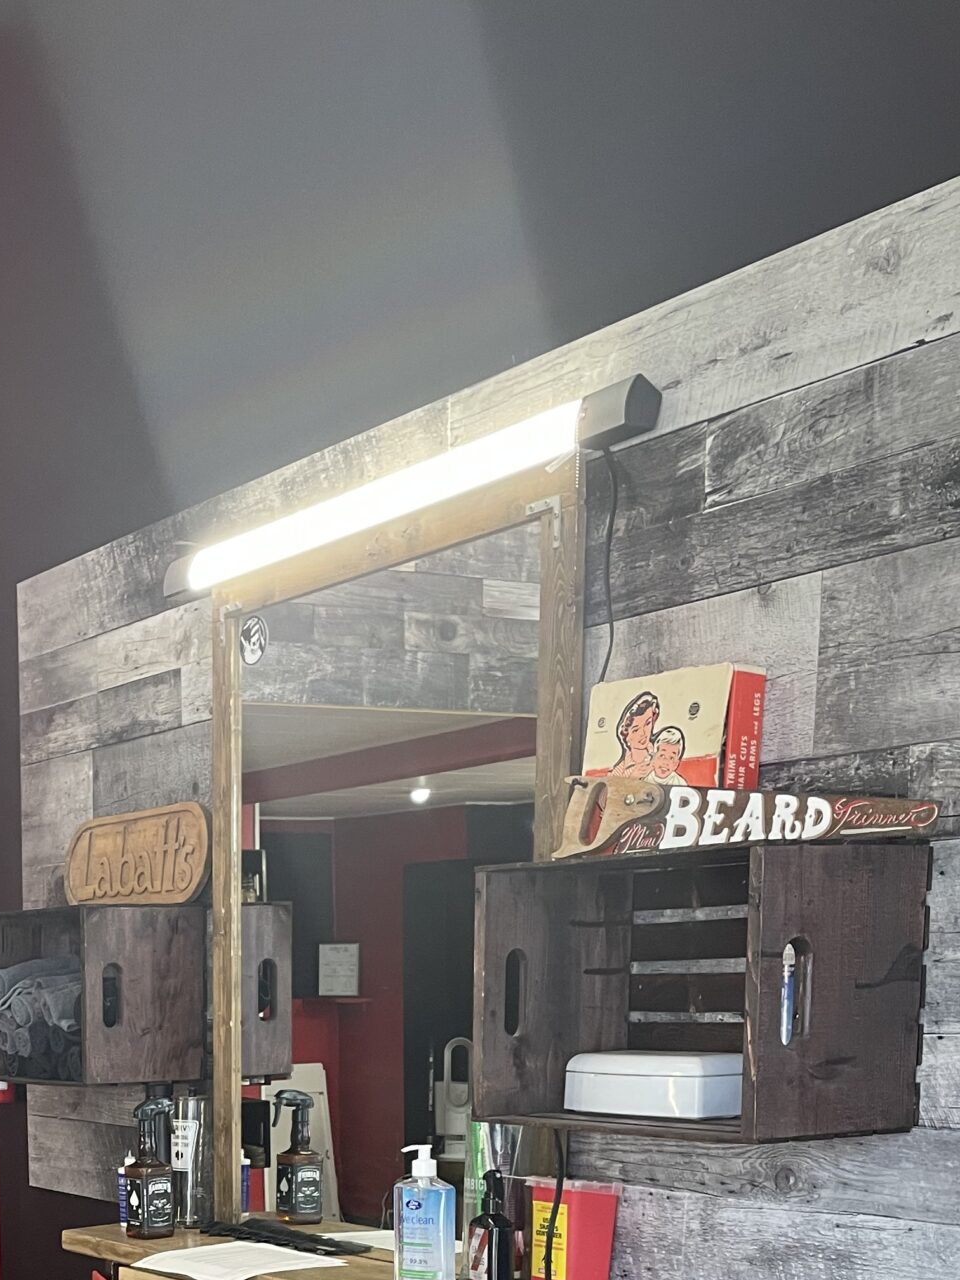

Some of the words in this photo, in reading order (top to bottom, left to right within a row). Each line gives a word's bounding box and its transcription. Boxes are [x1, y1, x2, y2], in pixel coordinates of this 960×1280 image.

[740, 735, 748, 761] CUTS
[748, 739, 757, 769] ARMS
[753, 692, 761, 717] LEGS
[727, 753, 737, 785] TRIMS
[659, 786, 832, 849] BEARD
[77, 816, 197, 902] Labatt's
